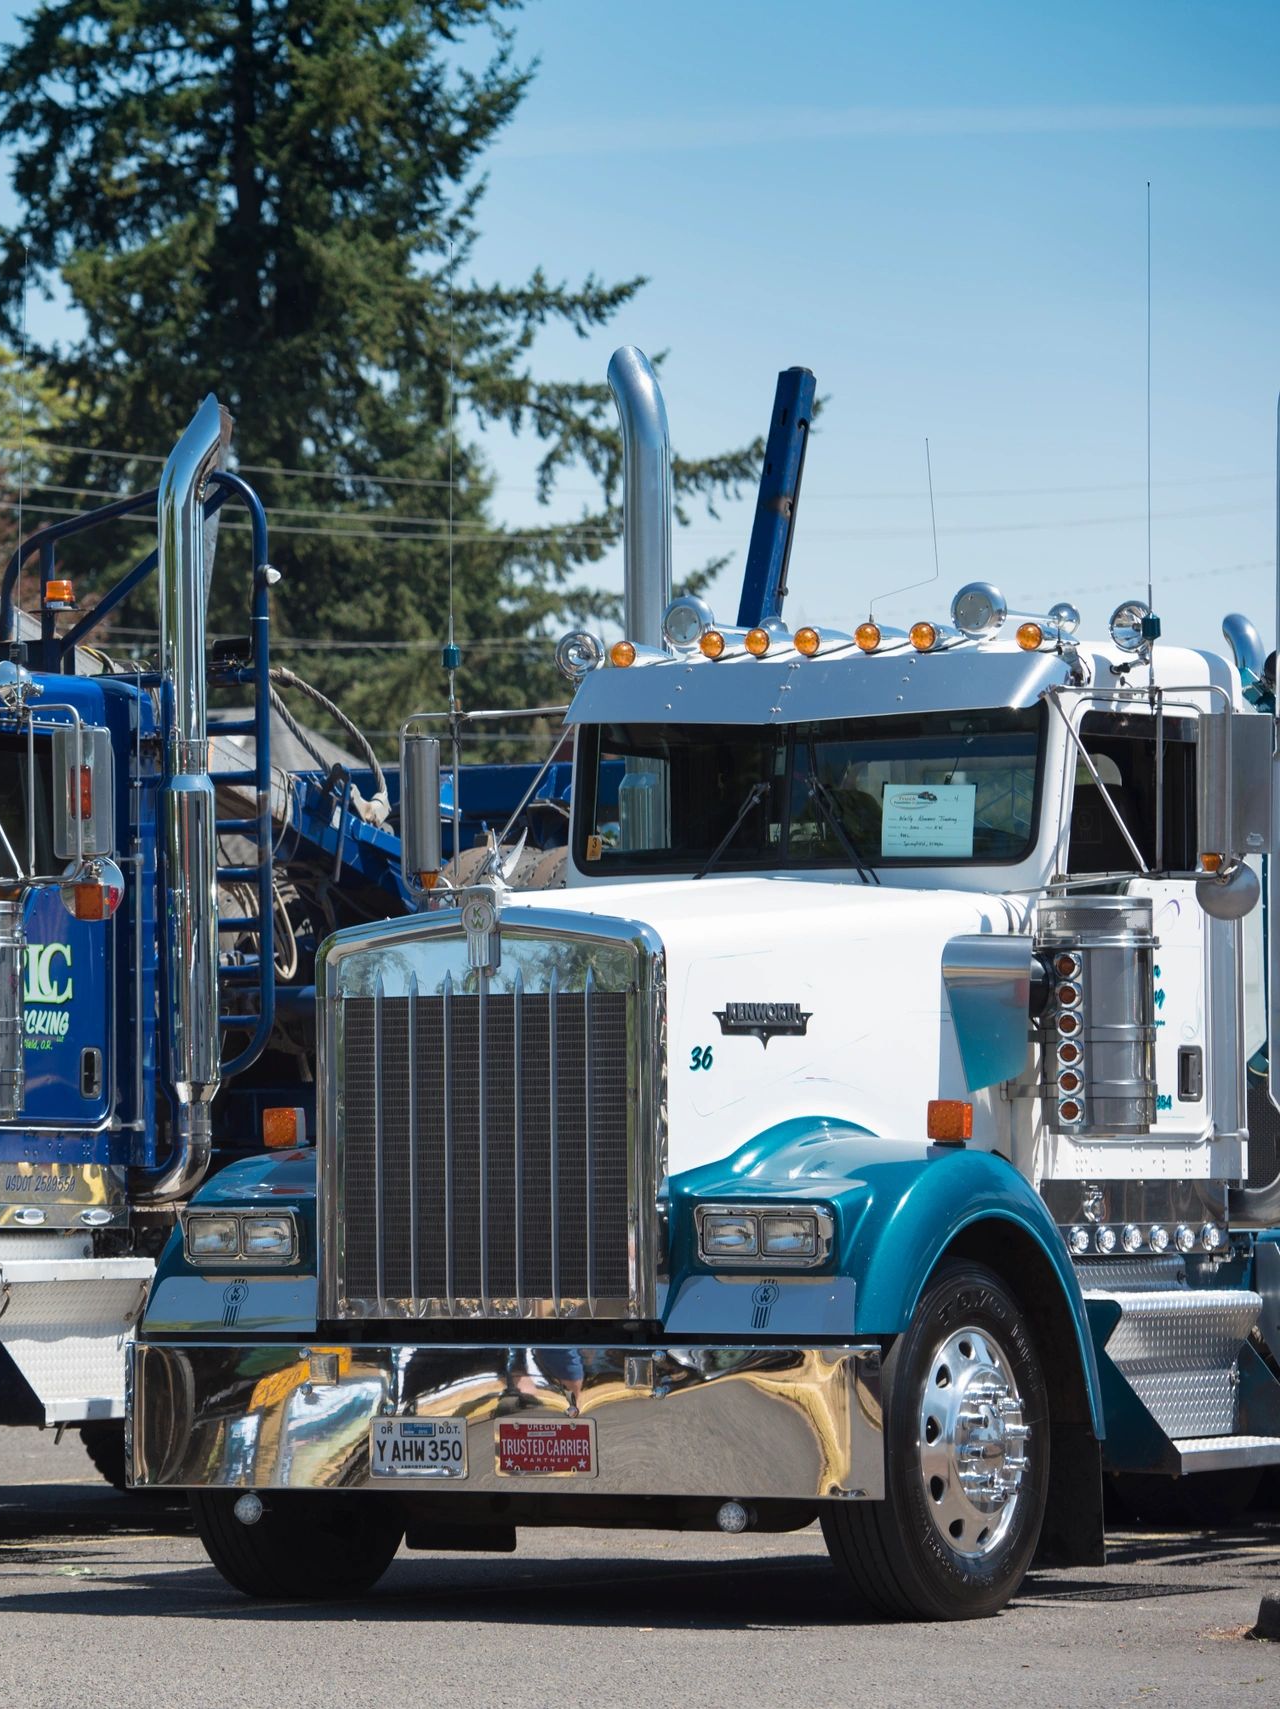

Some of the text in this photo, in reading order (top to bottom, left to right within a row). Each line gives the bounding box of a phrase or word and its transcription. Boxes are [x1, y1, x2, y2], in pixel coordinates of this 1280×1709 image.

[725, 1002, 801, 1022] KENWORTH
[688, 1045, 713, 1071] 36
[5, 1175, 33, 1192] USDOT
[381, 1426, 393, 1434] OR
[501, 1439, 589, 1457] TRUSTED CARRIER
